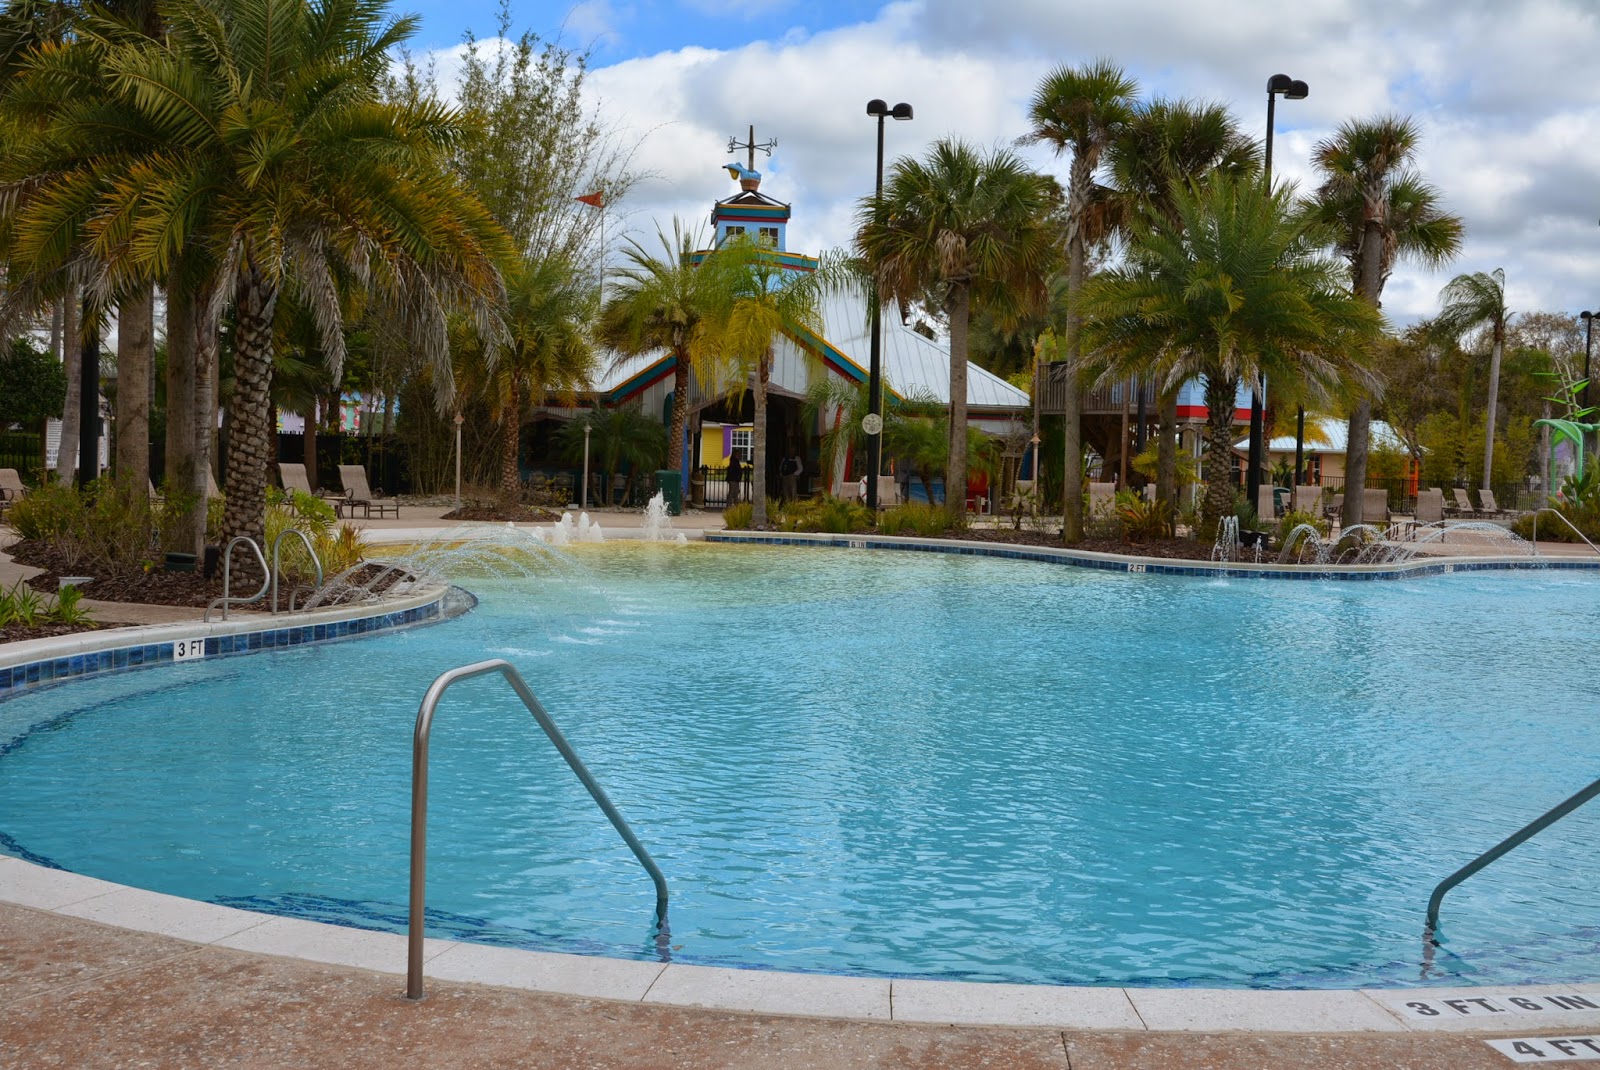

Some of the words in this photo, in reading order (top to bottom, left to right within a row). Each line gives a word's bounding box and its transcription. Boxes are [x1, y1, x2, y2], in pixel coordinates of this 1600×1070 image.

[858, 541, 865, 549] IN
[1130, 563, 1135, 572] 2
[1136, 564, 1145, 573] FT
[178, 642, 186, 657] 3
[190, 640, 204, 656] FT
[1406, 1001, 1440, 1016] 3
[1442, 998, 1506, 1014] FT.
[1508, 997, 1543, 1011] 6
[1543, 995, 1600, 1010] IN
[1512, 1041, 1547, 1058] 4
[1547, 1038, 1600, 1056] FT
